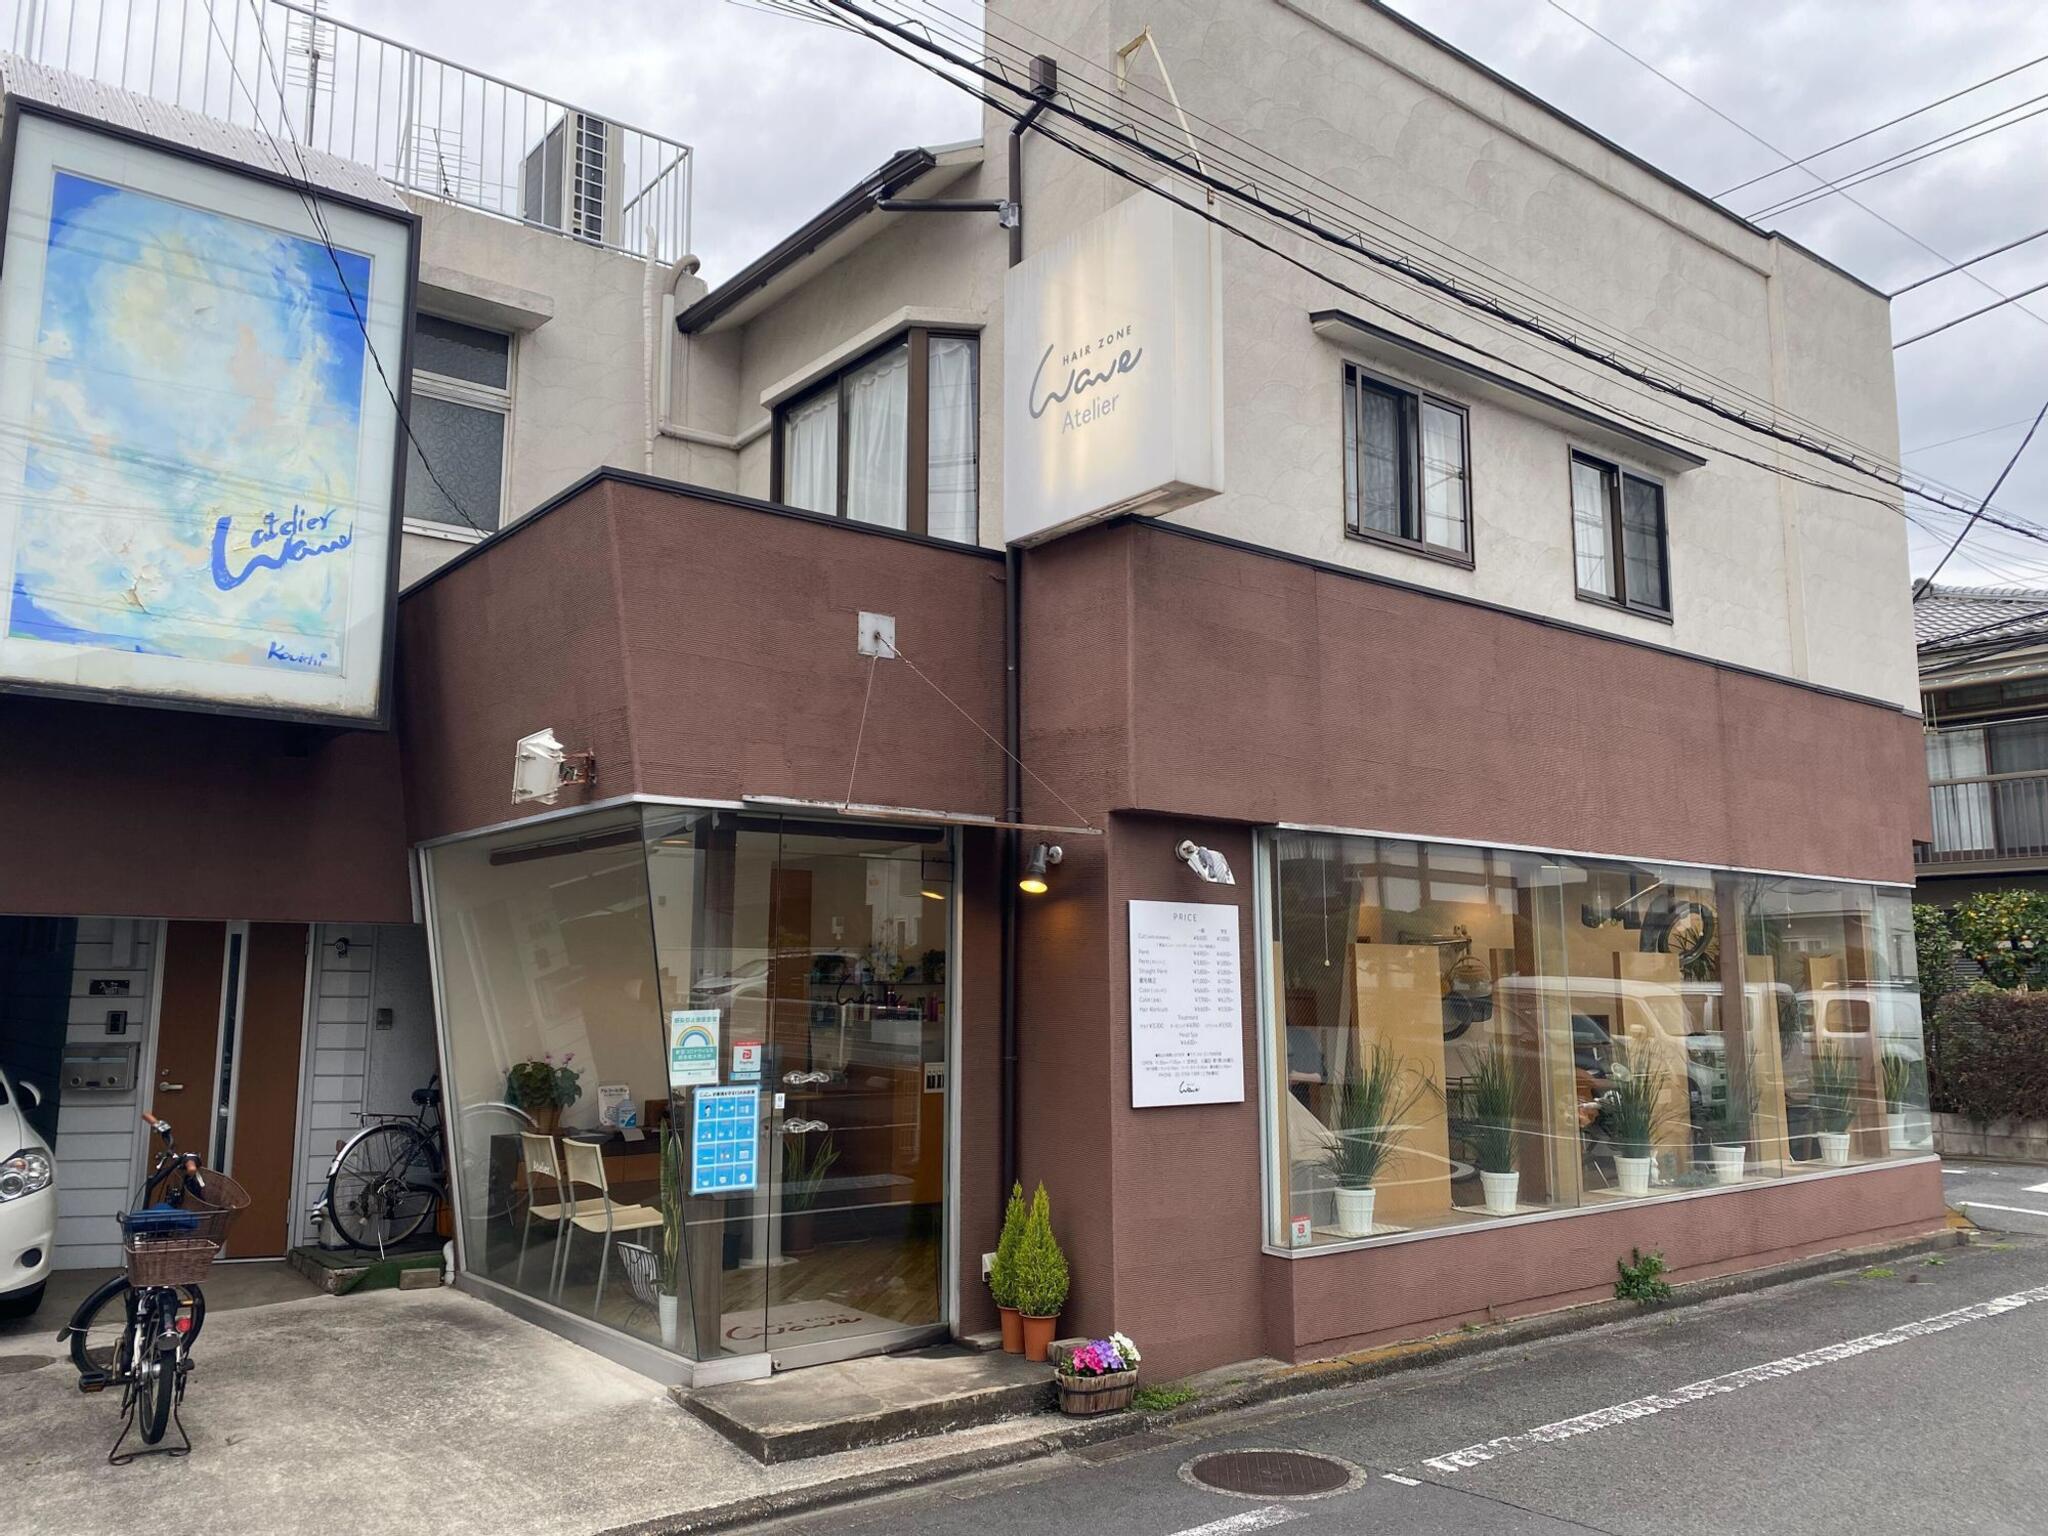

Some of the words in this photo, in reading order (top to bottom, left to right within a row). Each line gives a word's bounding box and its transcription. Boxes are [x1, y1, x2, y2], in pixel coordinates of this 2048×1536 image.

[1062, 345, 1091, 366] HAIR
[1098, 325, 1132, 349] ZONE
[1028, 343, 1143, 419] Wave
[1062, 394, 1119, 435] Atelier
[1172, 912, 1198, 922] PRICE
